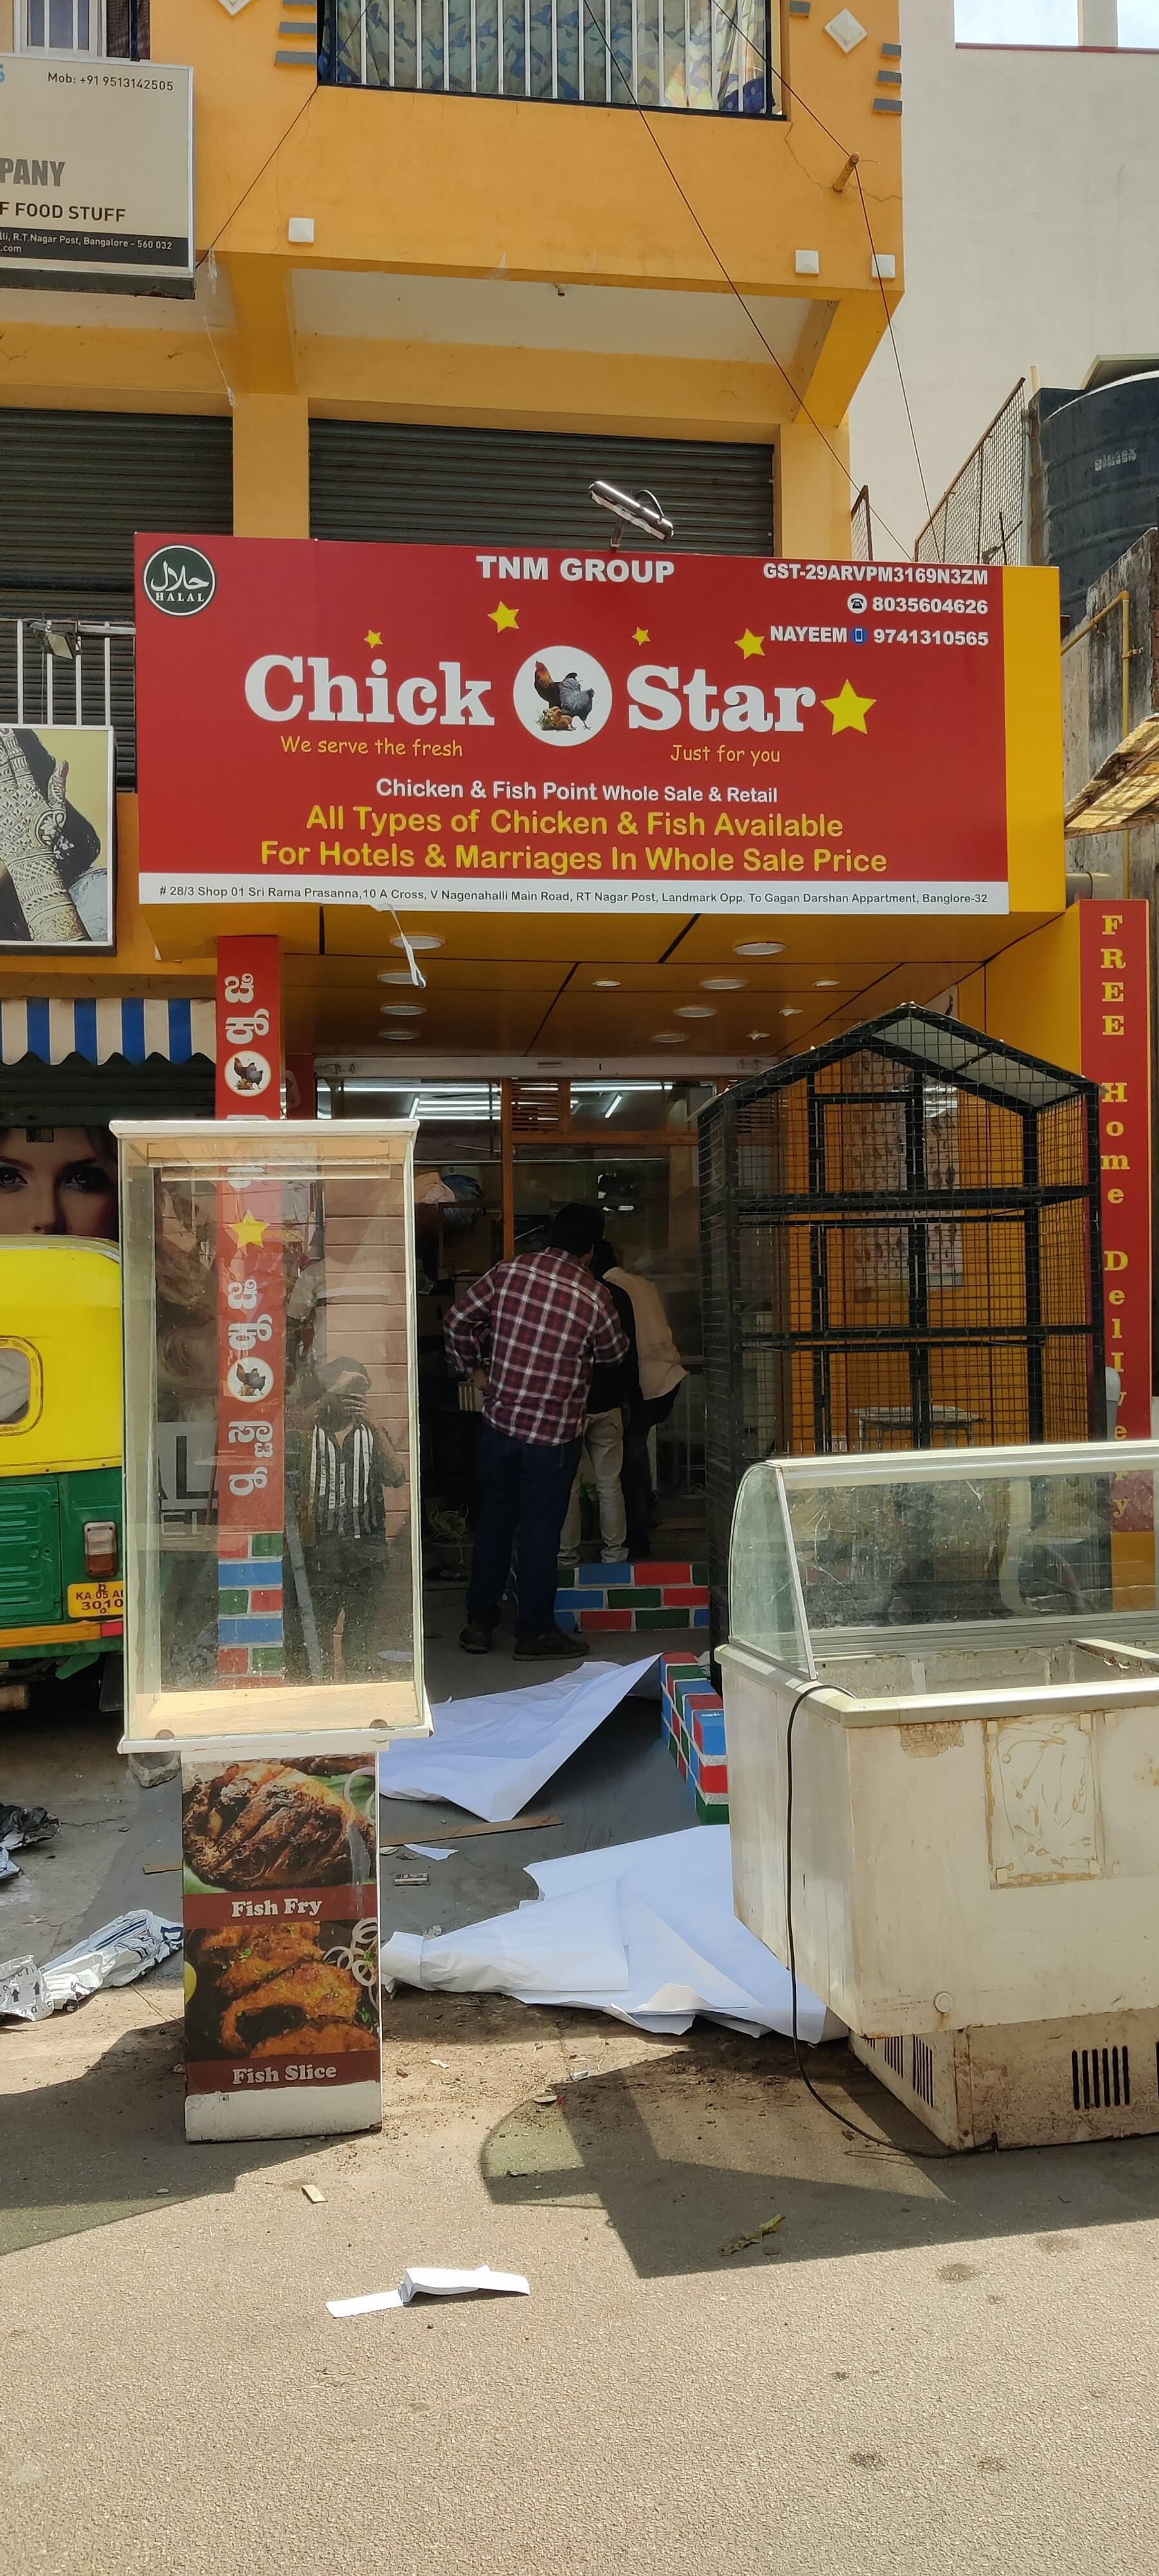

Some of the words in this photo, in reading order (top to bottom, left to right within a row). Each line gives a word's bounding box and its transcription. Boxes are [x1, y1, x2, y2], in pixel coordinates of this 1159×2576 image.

[48, 71, 76, 84] Mob:
[79, 75, 99, 86] +91
[102, 76, 173, 91] 9513142505
[15, 202, 63, 218] FOOD
[68, 205, 126, 222] STUFF
[13, 232, 57, 245] R.T.Nagar
[59, 235, 81, 246] Post,
[83, 236, 129, 248] Bangalore
[137, 240, 153, 249] 560
[155, 241, 173, 250] 032
[476, 555, 549, 580] TNM
[560, 558, 675, 583] GROUP
[763, 563, 988, 585] GST-29ARVPM3169N3ZM
[155, 592, 205, 602] HALAL
[872, 596, 988, 614] 8035604626
[770, 625, 847, 643] NAYEEM
[873, 629, 989, 646] 9741310565
[245, 654, 495, 726] Chick
[627, 665, 816, 732] Star
[280, 735, 312, 753] We
[317, 740, 368, 754] serve
[374, 737, 406, 755] the
[412, 738, 463, 757] fresh
[670, 744, 711, 761] Just
[717, 744, 745, 762] for
[750, 750, 780, 767] you
[376, 778, 464, 798] Chicken
[470, 780, 487, 799] &
[493, 781, 536, 799] Fish
[543, 782, 598, 800] Point
[602, 784, 659, 801] Whole
[664, 786, 703, 802] Sale
[708, 786, 722, 802] &
[727, 787, 777, 803] Retail
[306, 804, 344, 830] All
[352, 806, 442, 837] Types
[451, 808, 480, 833] of
[491, 809, 607, 835] Chicken
[617, 811, 639, 835] &
[648, 811, 705, 836] Fish
[714, 812, 843, 837] Available
[261, 840, 311, 865] For
[320, 841, 415, 867] Hotels
[424, 844, 447, 868] &
[456, 844, 602, 875] Marriages
[612, 846, 637, 871] In
[645, 847, 734, 871] Whole
[743, 848, 804, 872] Sale
[814, 849, 887, 872] Price
[160, 886, 167, 896] #
[169, 886, 194, 896] 28/3
[198, 886, 228, 899] Shop
[231, 887, 243, 896] 01
[249, 887, 265, 897] Sri
[268, 887, 301, 897] Rama
[379, 889, 388, 899] A
[391, 889, 427, 901] Cross,
[430, 889, 438, 899] V
[442, 890, 508, 902] Nagenahalli
[511, 891, 538, 901] Main
[542, 891, 573, 903] Road,
[576, 891, 592, 902] RT
[594, 892, 628, 904] Nagar
[631, 892, 659, 904] Post,
[662, 892, 717, 902] Landmark
[720, 893, 746, 905] Opp.
[748, 893, 762, 902] To
[764, 893, 800, 905] Gagan
[803, 893, 849, 903] Darshan
[851, 893, 919, 905] Appartment,
[922, 893, 988, 905] Banglore-32
[1098, 912, 1128, 1037] FREE
[1100, 1082, 1131, 1204] Home
[231, 1899, 279, 1917] Fish
[283, 1898, 323, 1916] Fry
[232, 2067, 280, 2085] Fish
[285, 2063, 337, 2081] Slice
